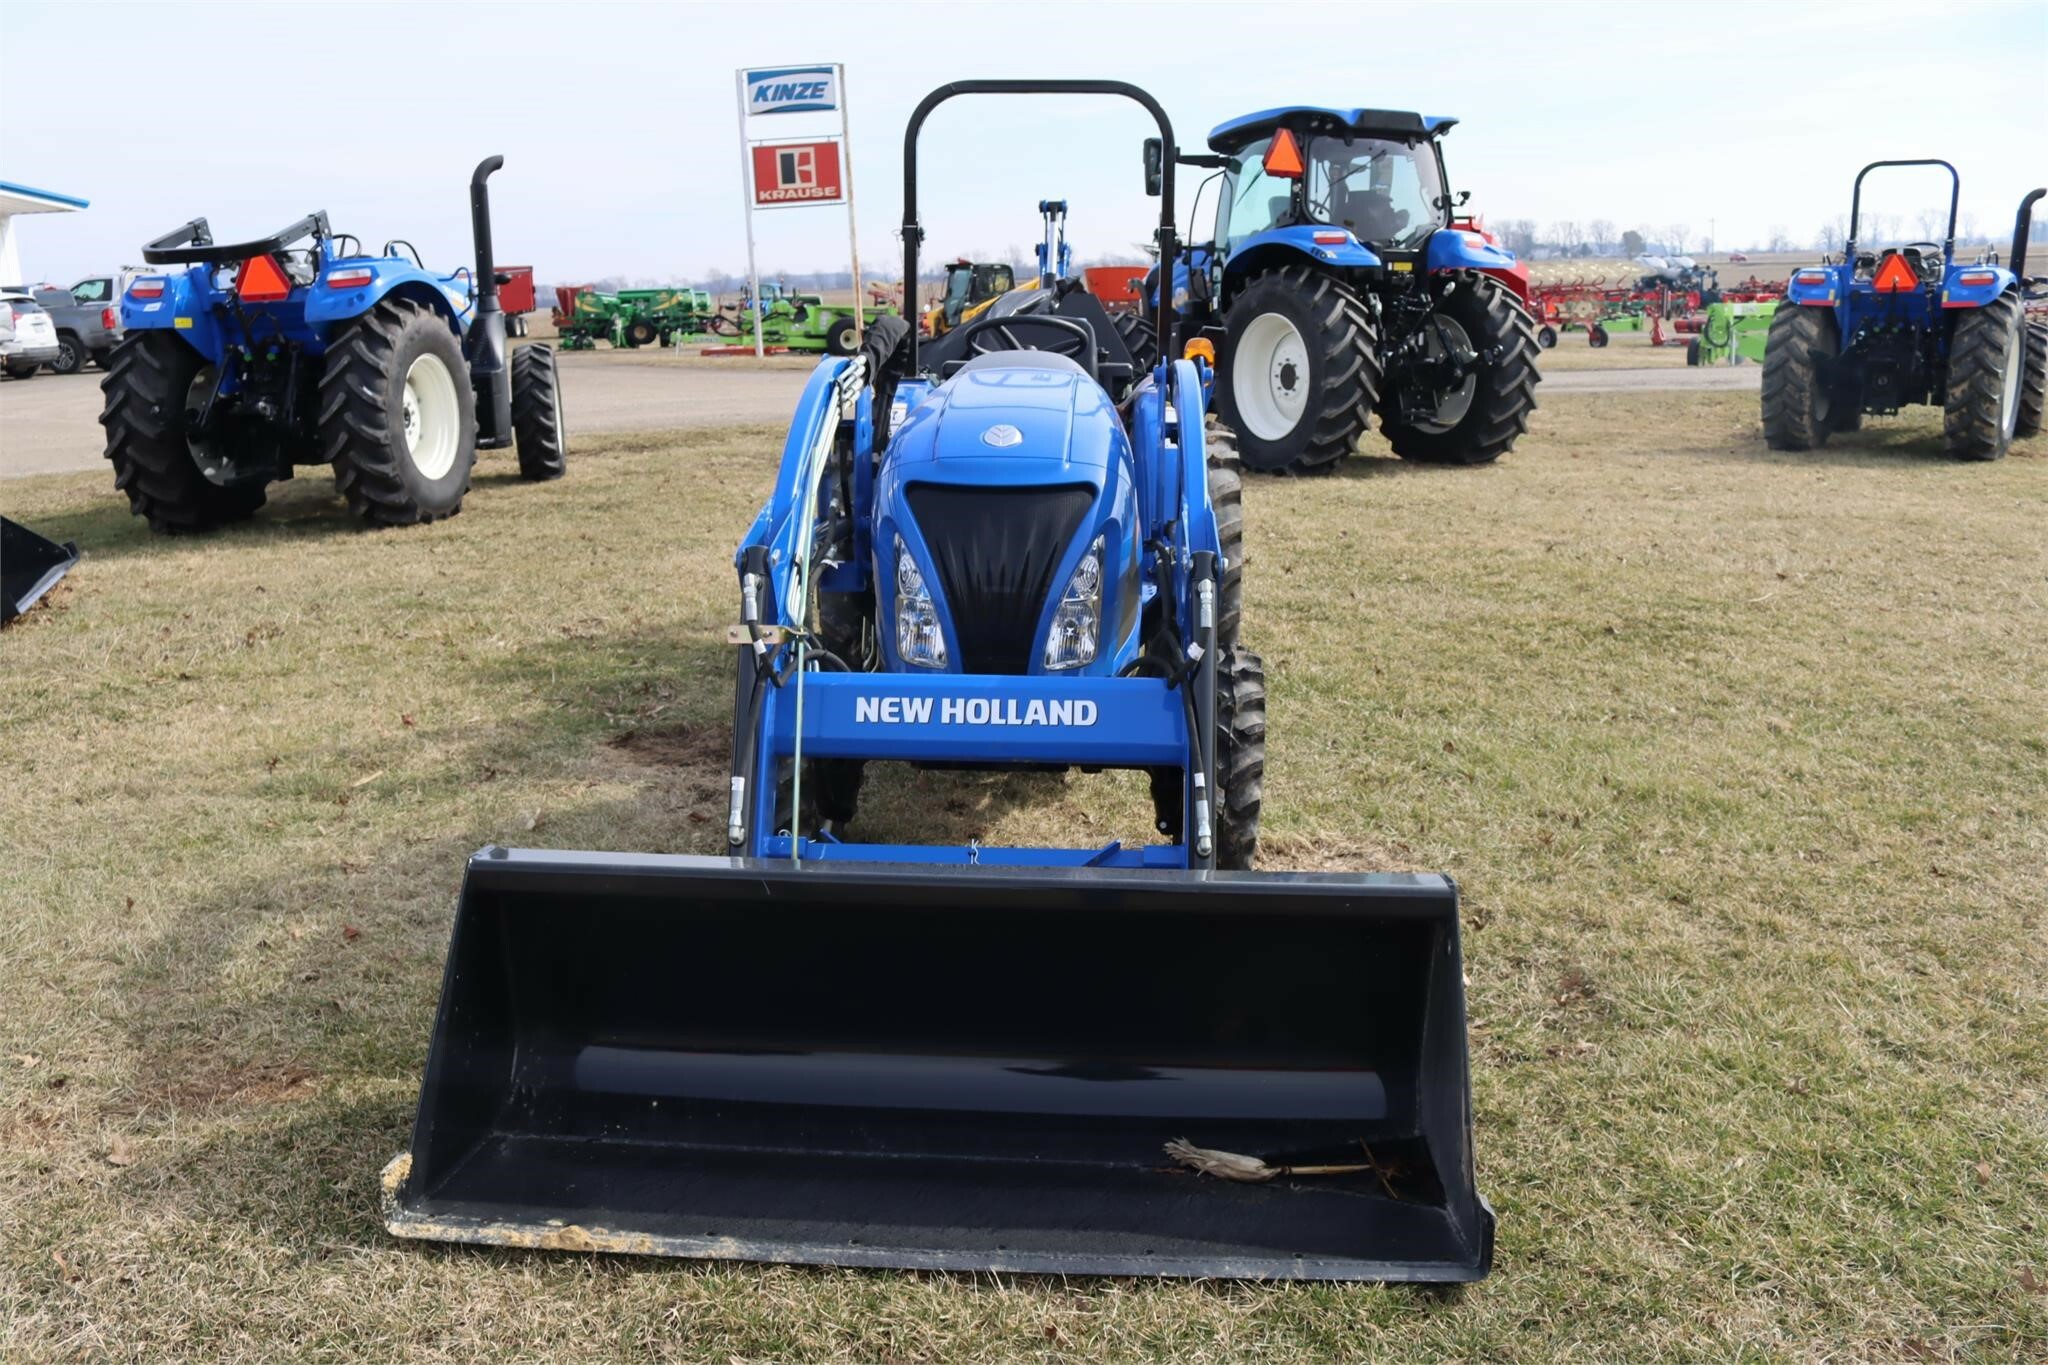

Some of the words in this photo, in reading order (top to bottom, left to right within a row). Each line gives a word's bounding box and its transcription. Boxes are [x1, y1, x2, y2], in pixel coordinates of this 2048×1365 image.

[753, 81, 829, 102] KINZE
[759, 186, 838, 201] KRAUSE
[855, 696, 934, 724] NEW
[941, 698, 1098, 726] HOLLAND
